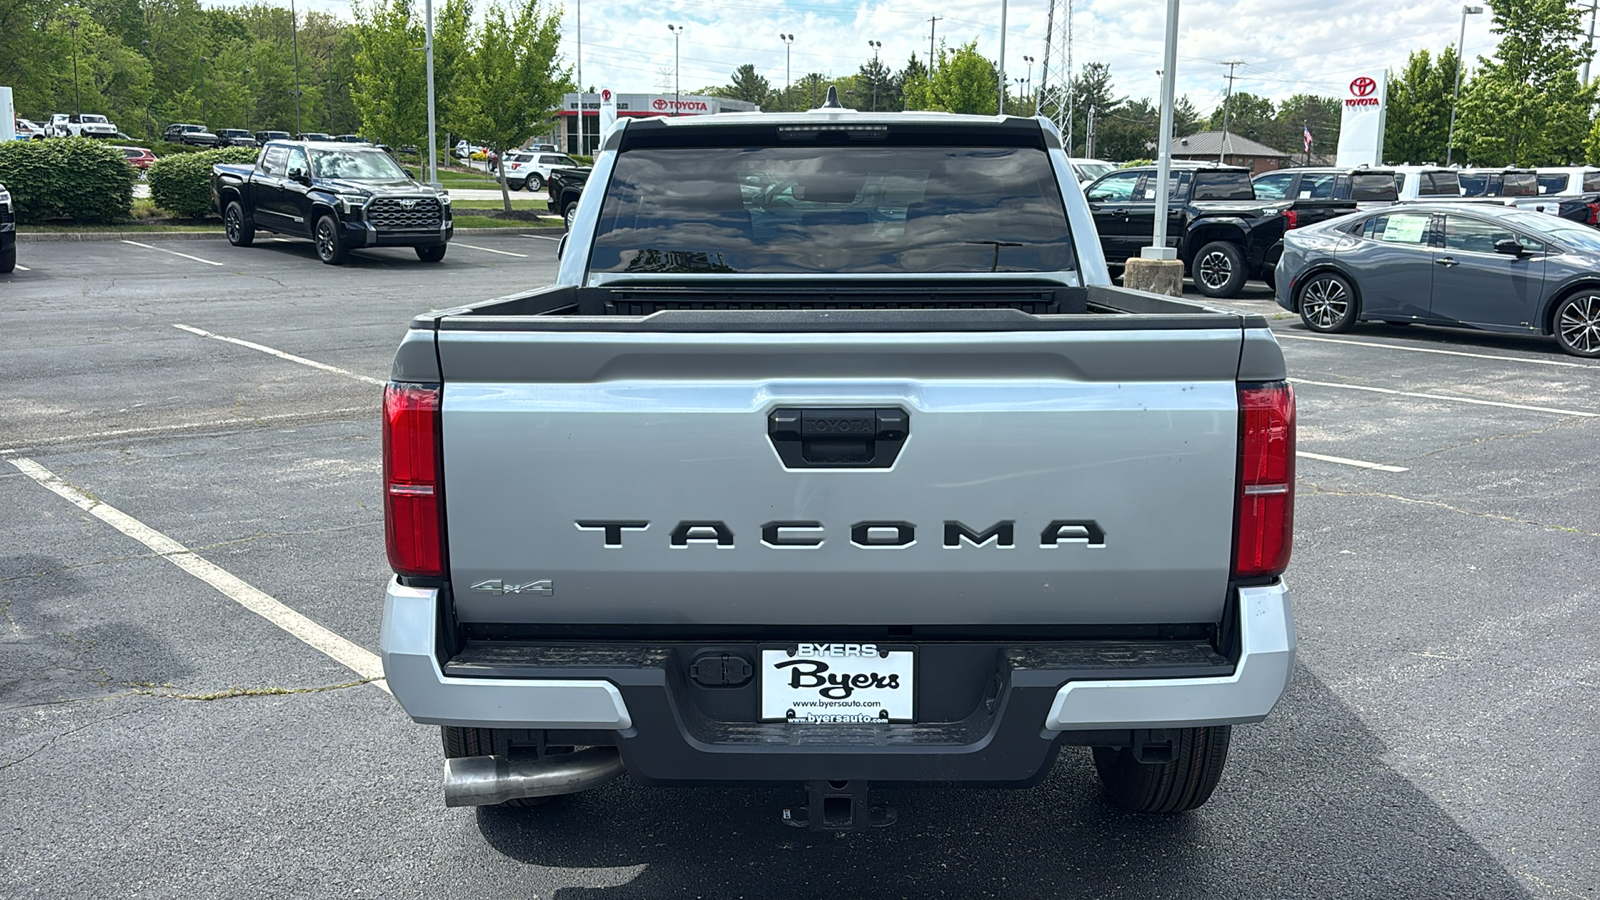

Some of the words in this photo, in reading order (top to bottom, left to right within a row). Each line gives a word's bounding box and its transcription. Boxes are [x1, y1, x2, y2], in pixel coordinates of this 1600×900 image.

[669, 101, 707, 110] TOYOTA
[1345, 98, 1379, 106] TOYOTA
[806, 420, 872, 432] TOYOTA
[574, 519, 1107, 550] TACOMA
[797, 643, 878, 658] BYERS
[773, 659, 900, 700] Byers
[792, 699, 881, 708] www.byersauto.com
[787, 712, 888, 725] www.byersauto.com
